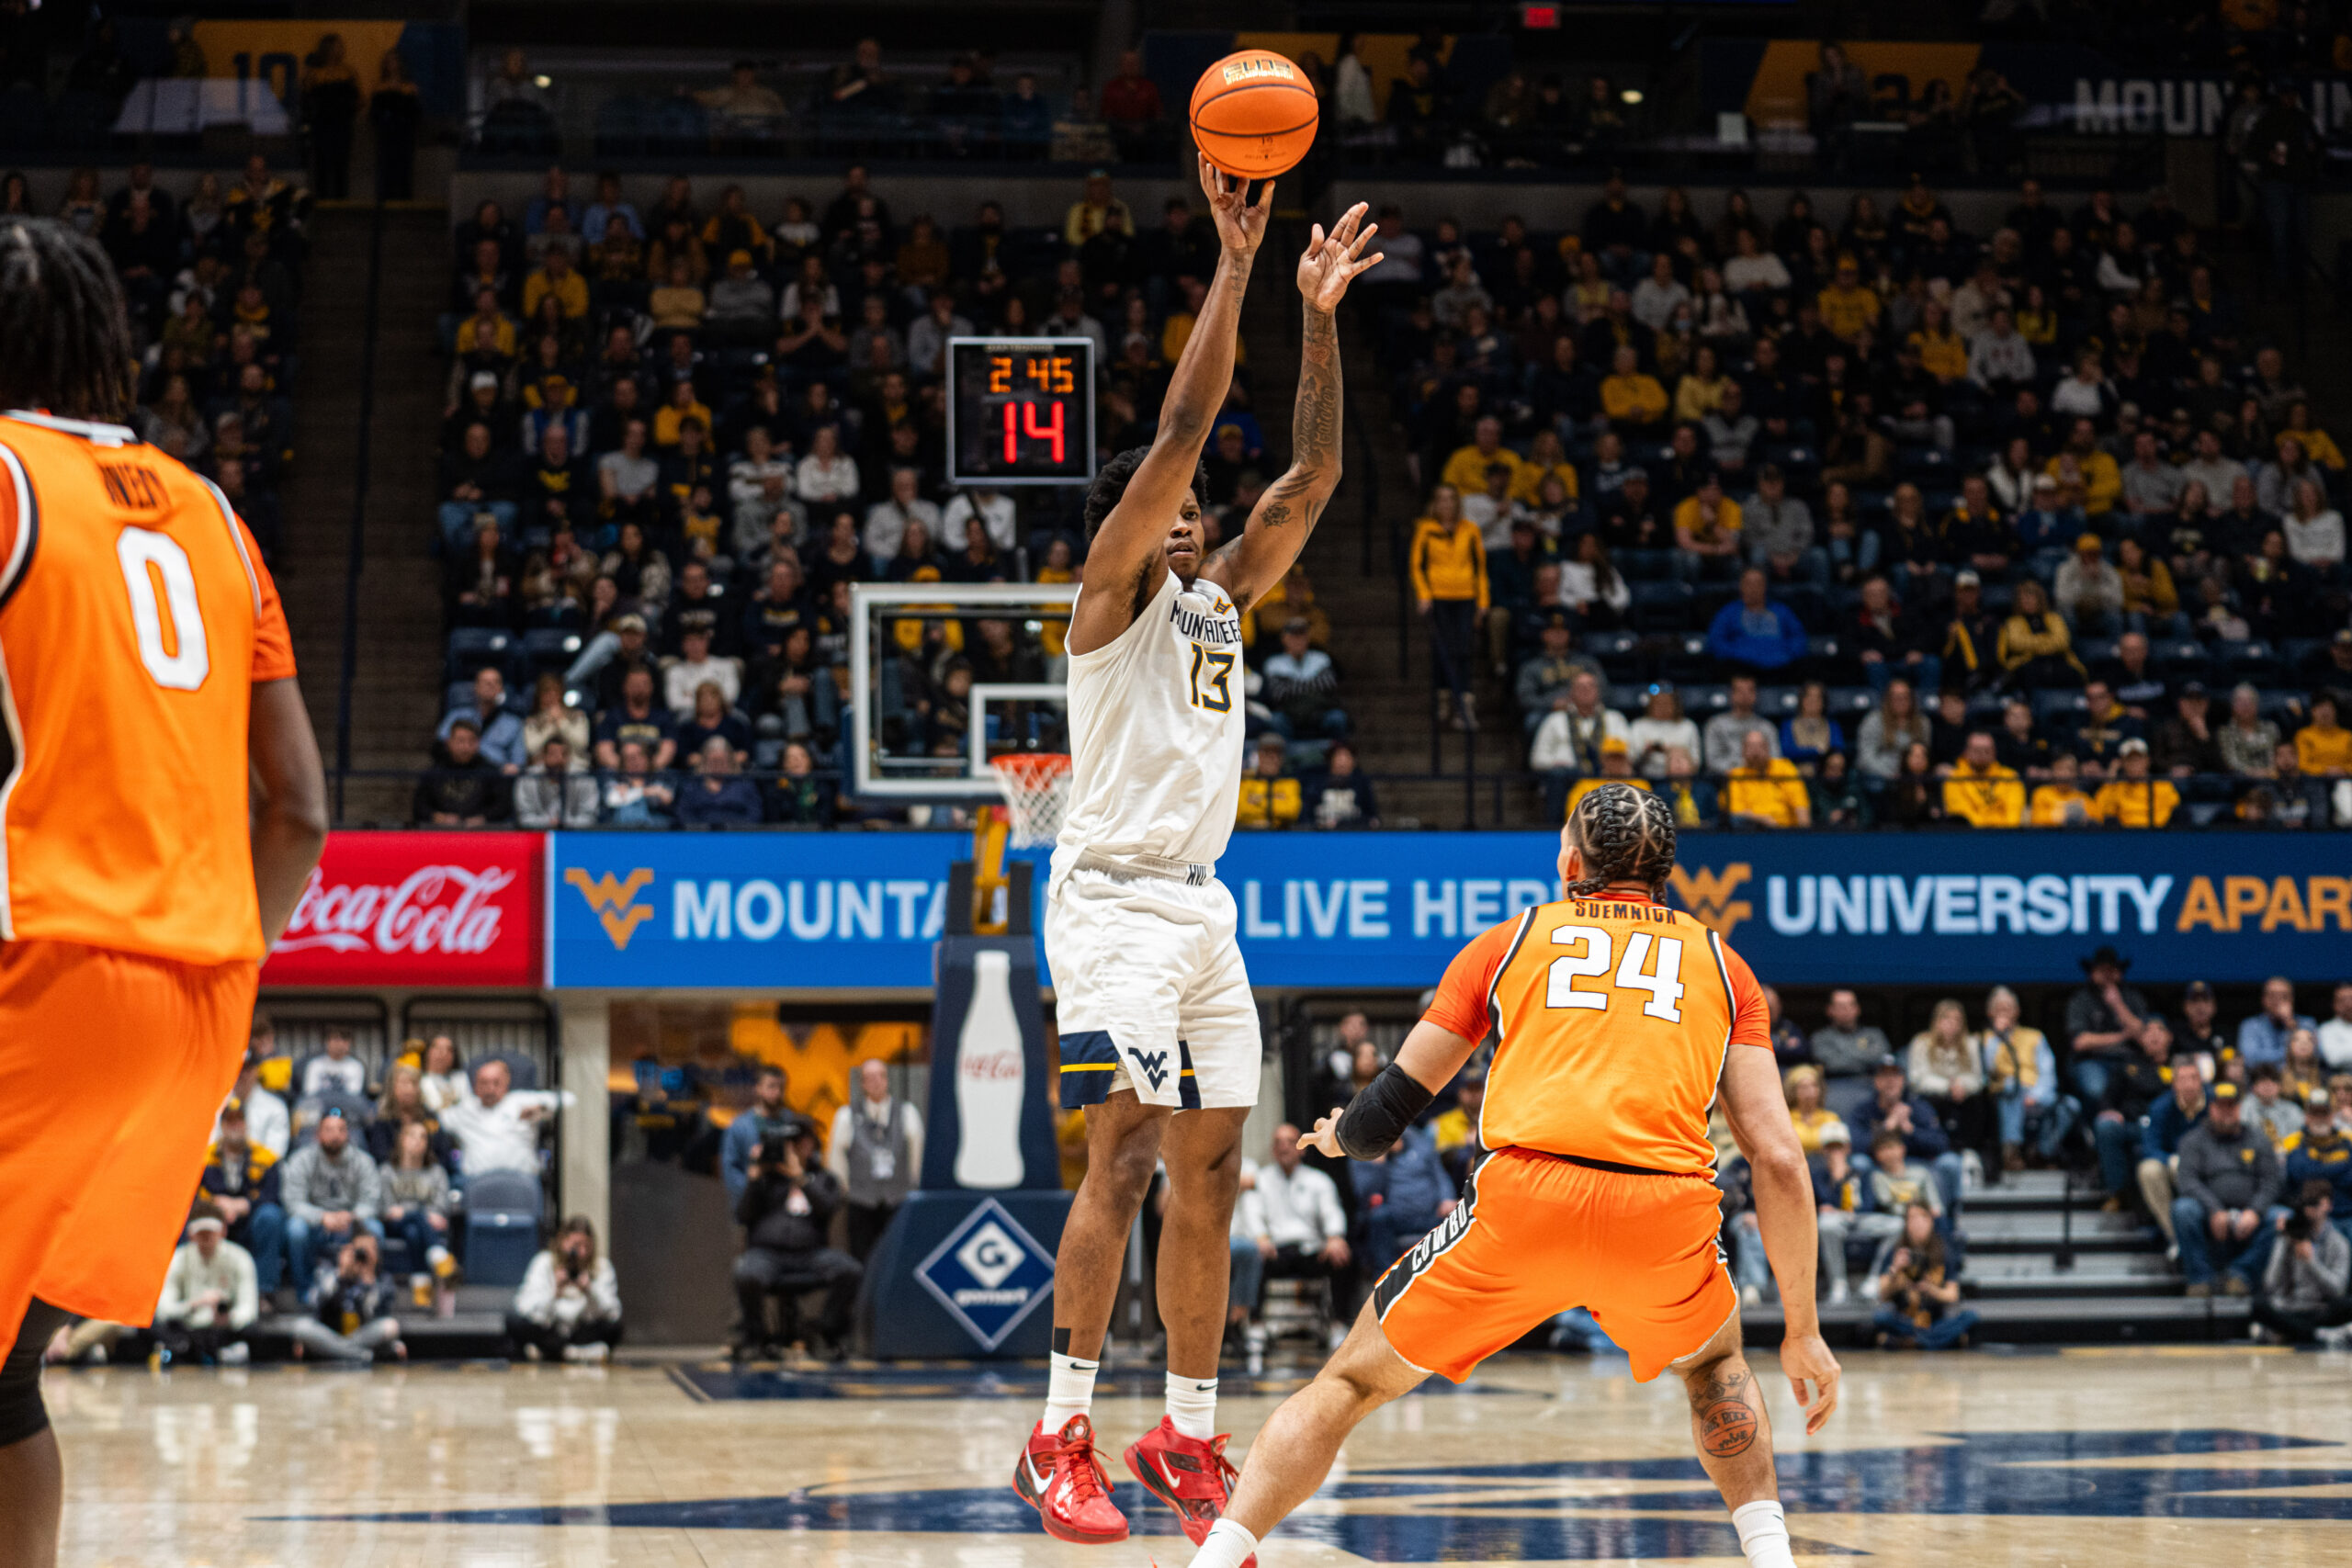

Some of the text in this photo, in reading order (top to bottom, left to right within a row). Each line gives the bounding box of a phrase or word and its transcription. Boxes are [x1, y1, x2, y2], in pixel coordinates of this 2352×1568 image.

[1003, 400, 1065, 464] 14
[116, 525, 210, 692] 0
[1191, 641, 1236, 714] 13
[274, 864, 516, 953] oca-Cola
[1244, 879, 1391, 939] LIVE
[1413, 879, 1562, 939] HER
[1767, 874, 2352, 936] UNIVERSITY APAR
[1545, 924, 1685, 1024] 24
